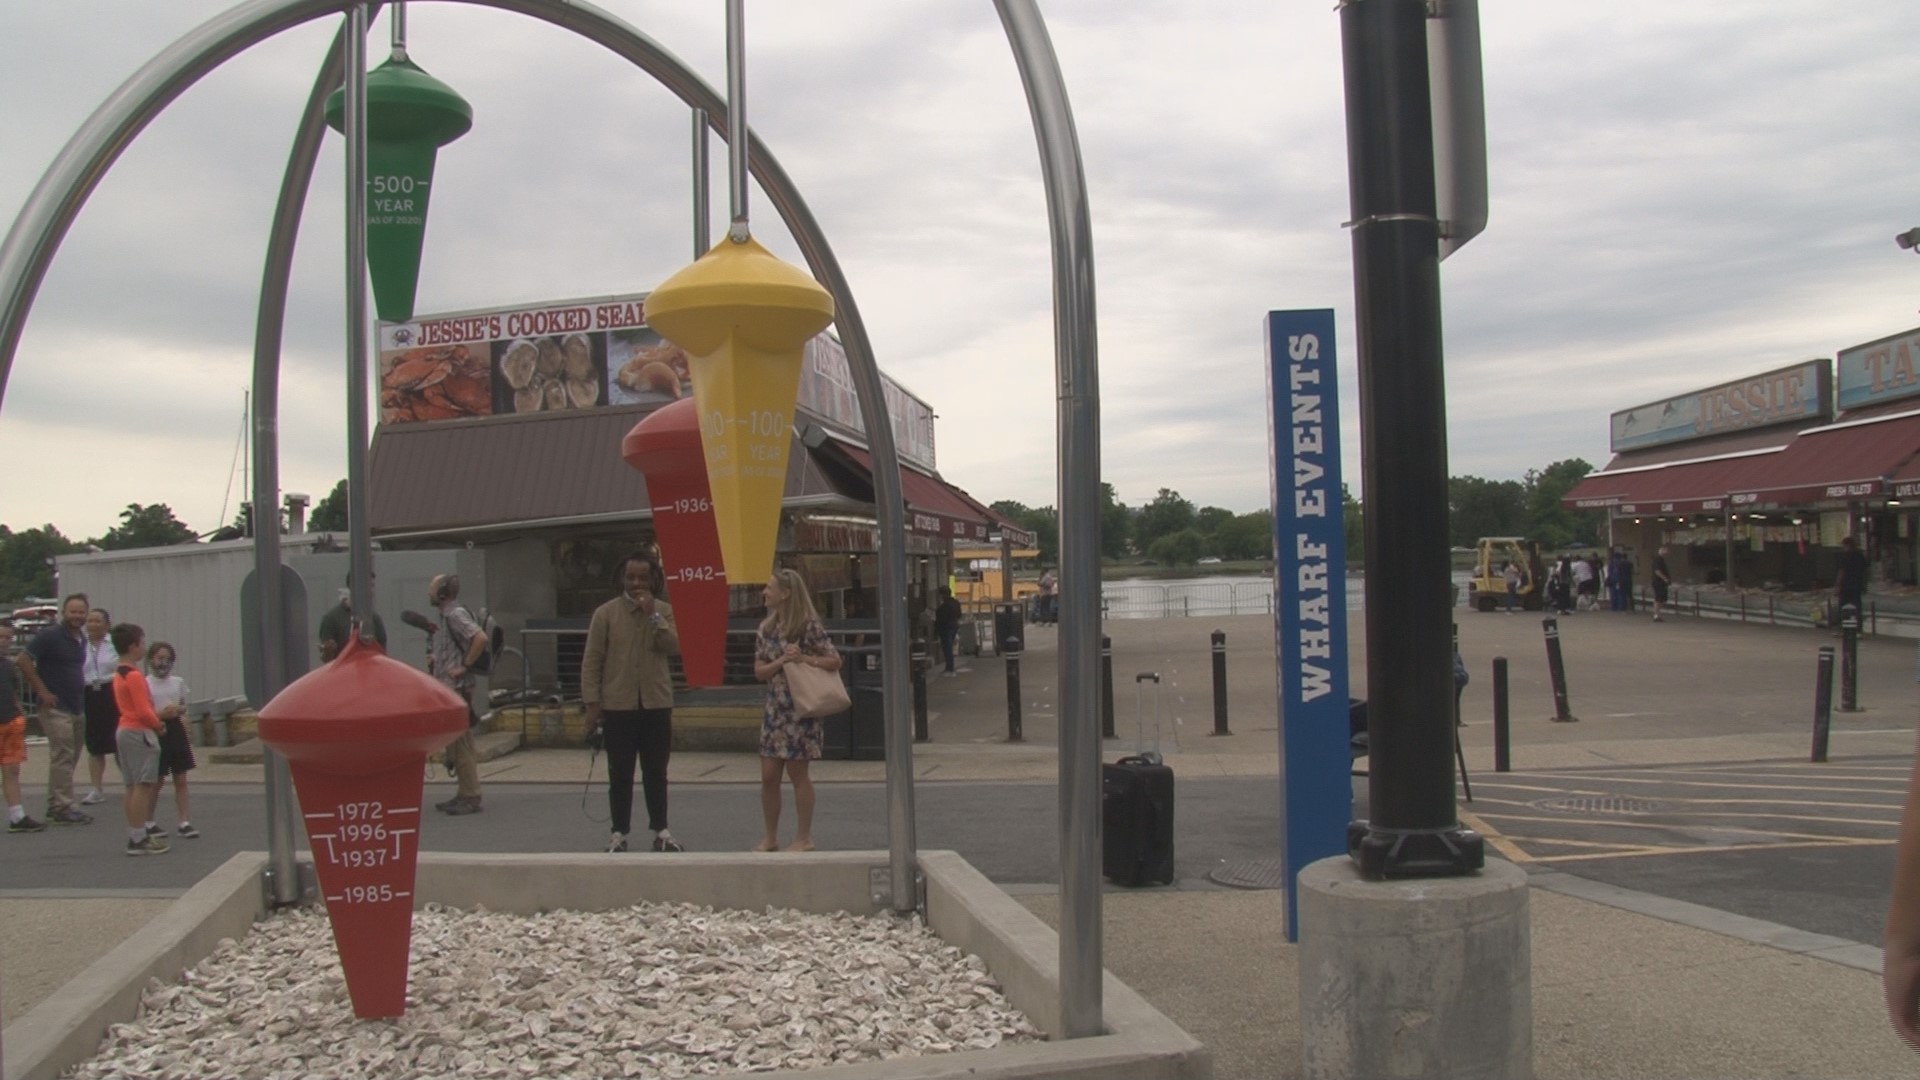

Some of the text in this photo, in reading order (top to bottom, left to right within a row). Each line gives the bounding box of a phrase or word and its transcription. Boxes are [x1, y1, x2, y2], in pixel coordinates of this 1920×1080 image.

[374, 176, 414, 193] 500
[374, 199, 414, 212] YEAR
[417, 315, 501, 346] JESSIE'S
[507, 310, 592, 338] COOKED
[1694, 370, 1805, 436] JESSIE
[675, 498, 708, 513] 1936
[1288, 333, 1332, 702] WHARF EVENTS
[680, 566, 714, 581] 1942
[337, 801, 383, 820] 1972
[338, 823, 387, 842] 1996
[341, 849, 387, 867] 1937
[344, 885, 393, 903] 1985
